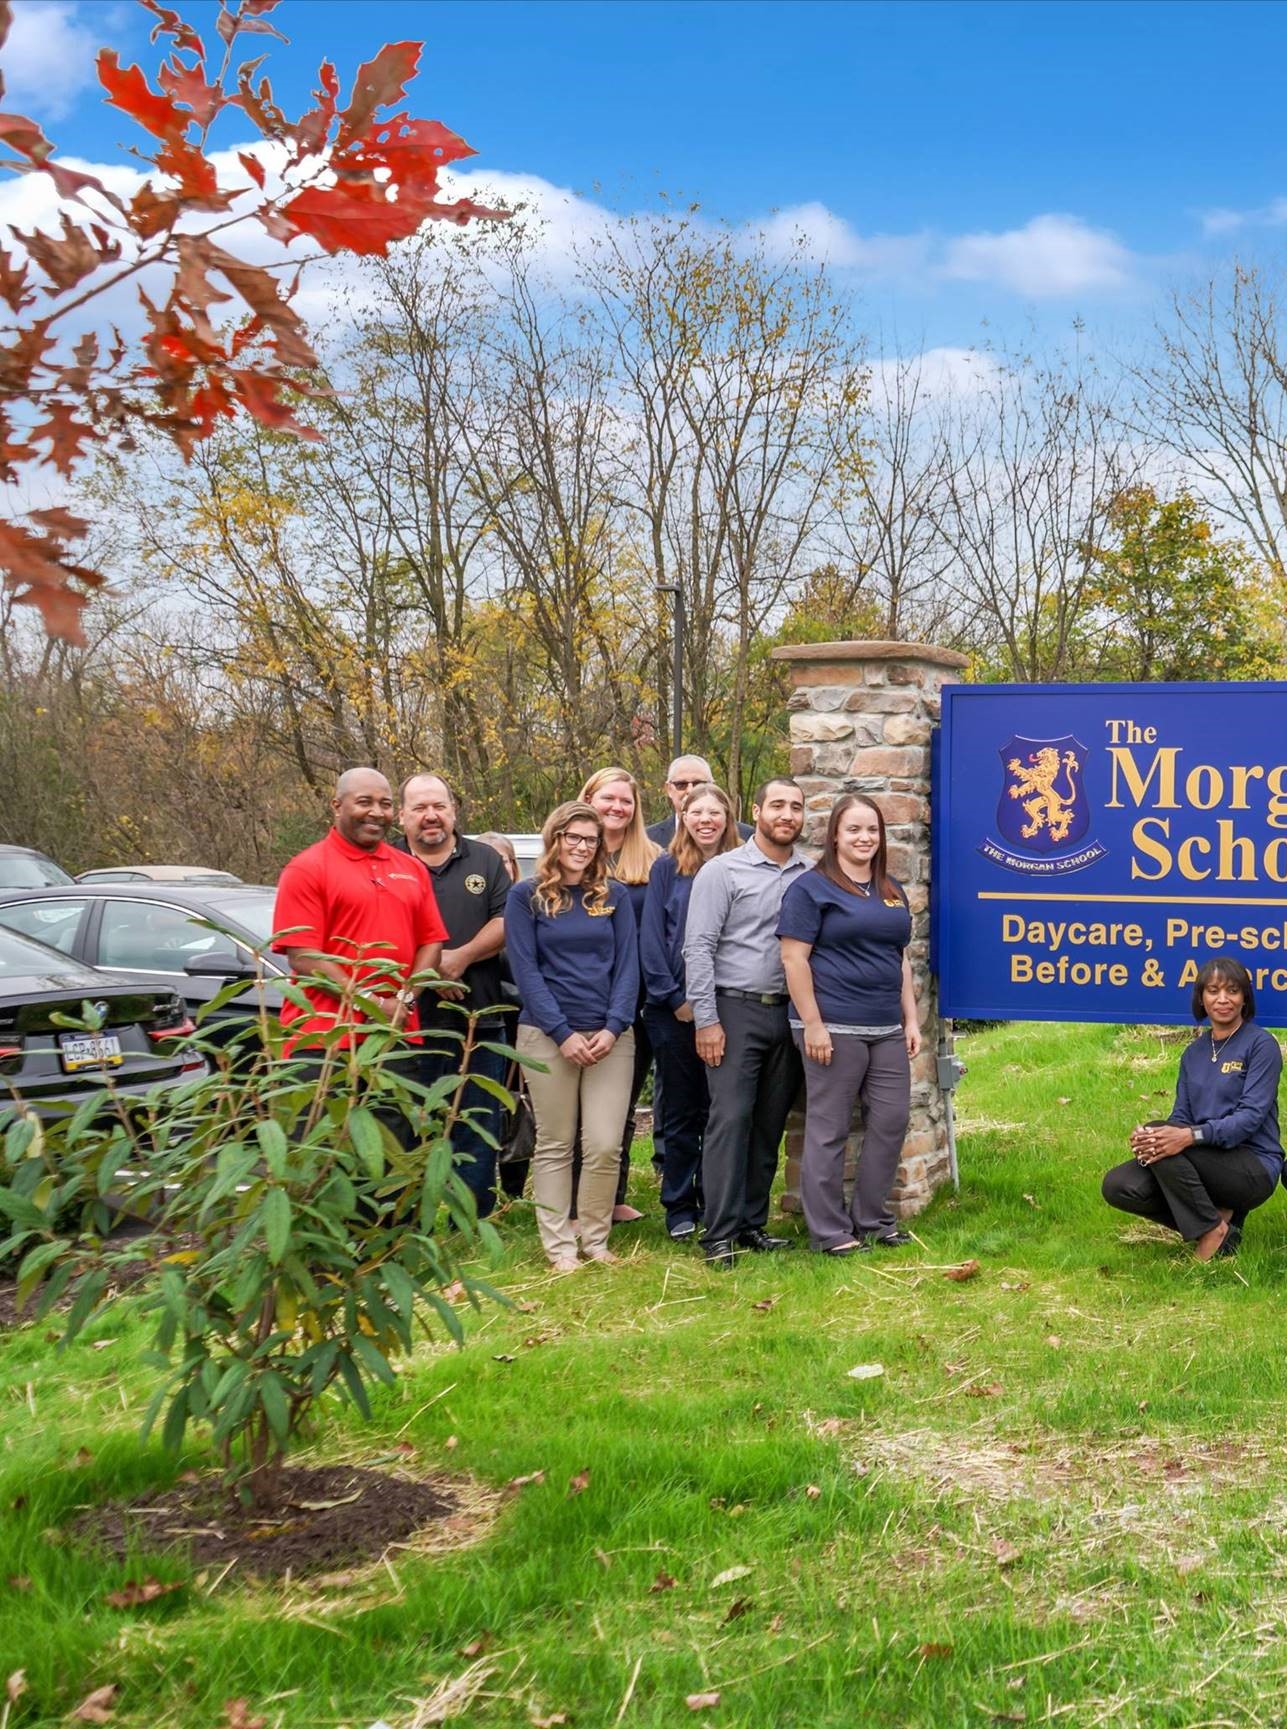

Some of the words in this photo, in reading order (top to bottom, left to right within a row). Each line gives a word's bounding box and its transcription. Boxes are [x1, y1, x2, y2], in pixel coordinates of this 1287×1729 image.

[1105, 719, 1157, 744] The
[983, 844, 1004, 861] THE
[1005, 857, 1054, 871] MORGAN
[1056, 846, 1102, 870] SCHOOL
[1002, 914, 1153, 951] Daycare,
[1011, 954, 1129, 985] Before
[1142, 958, 1165, 987] &
